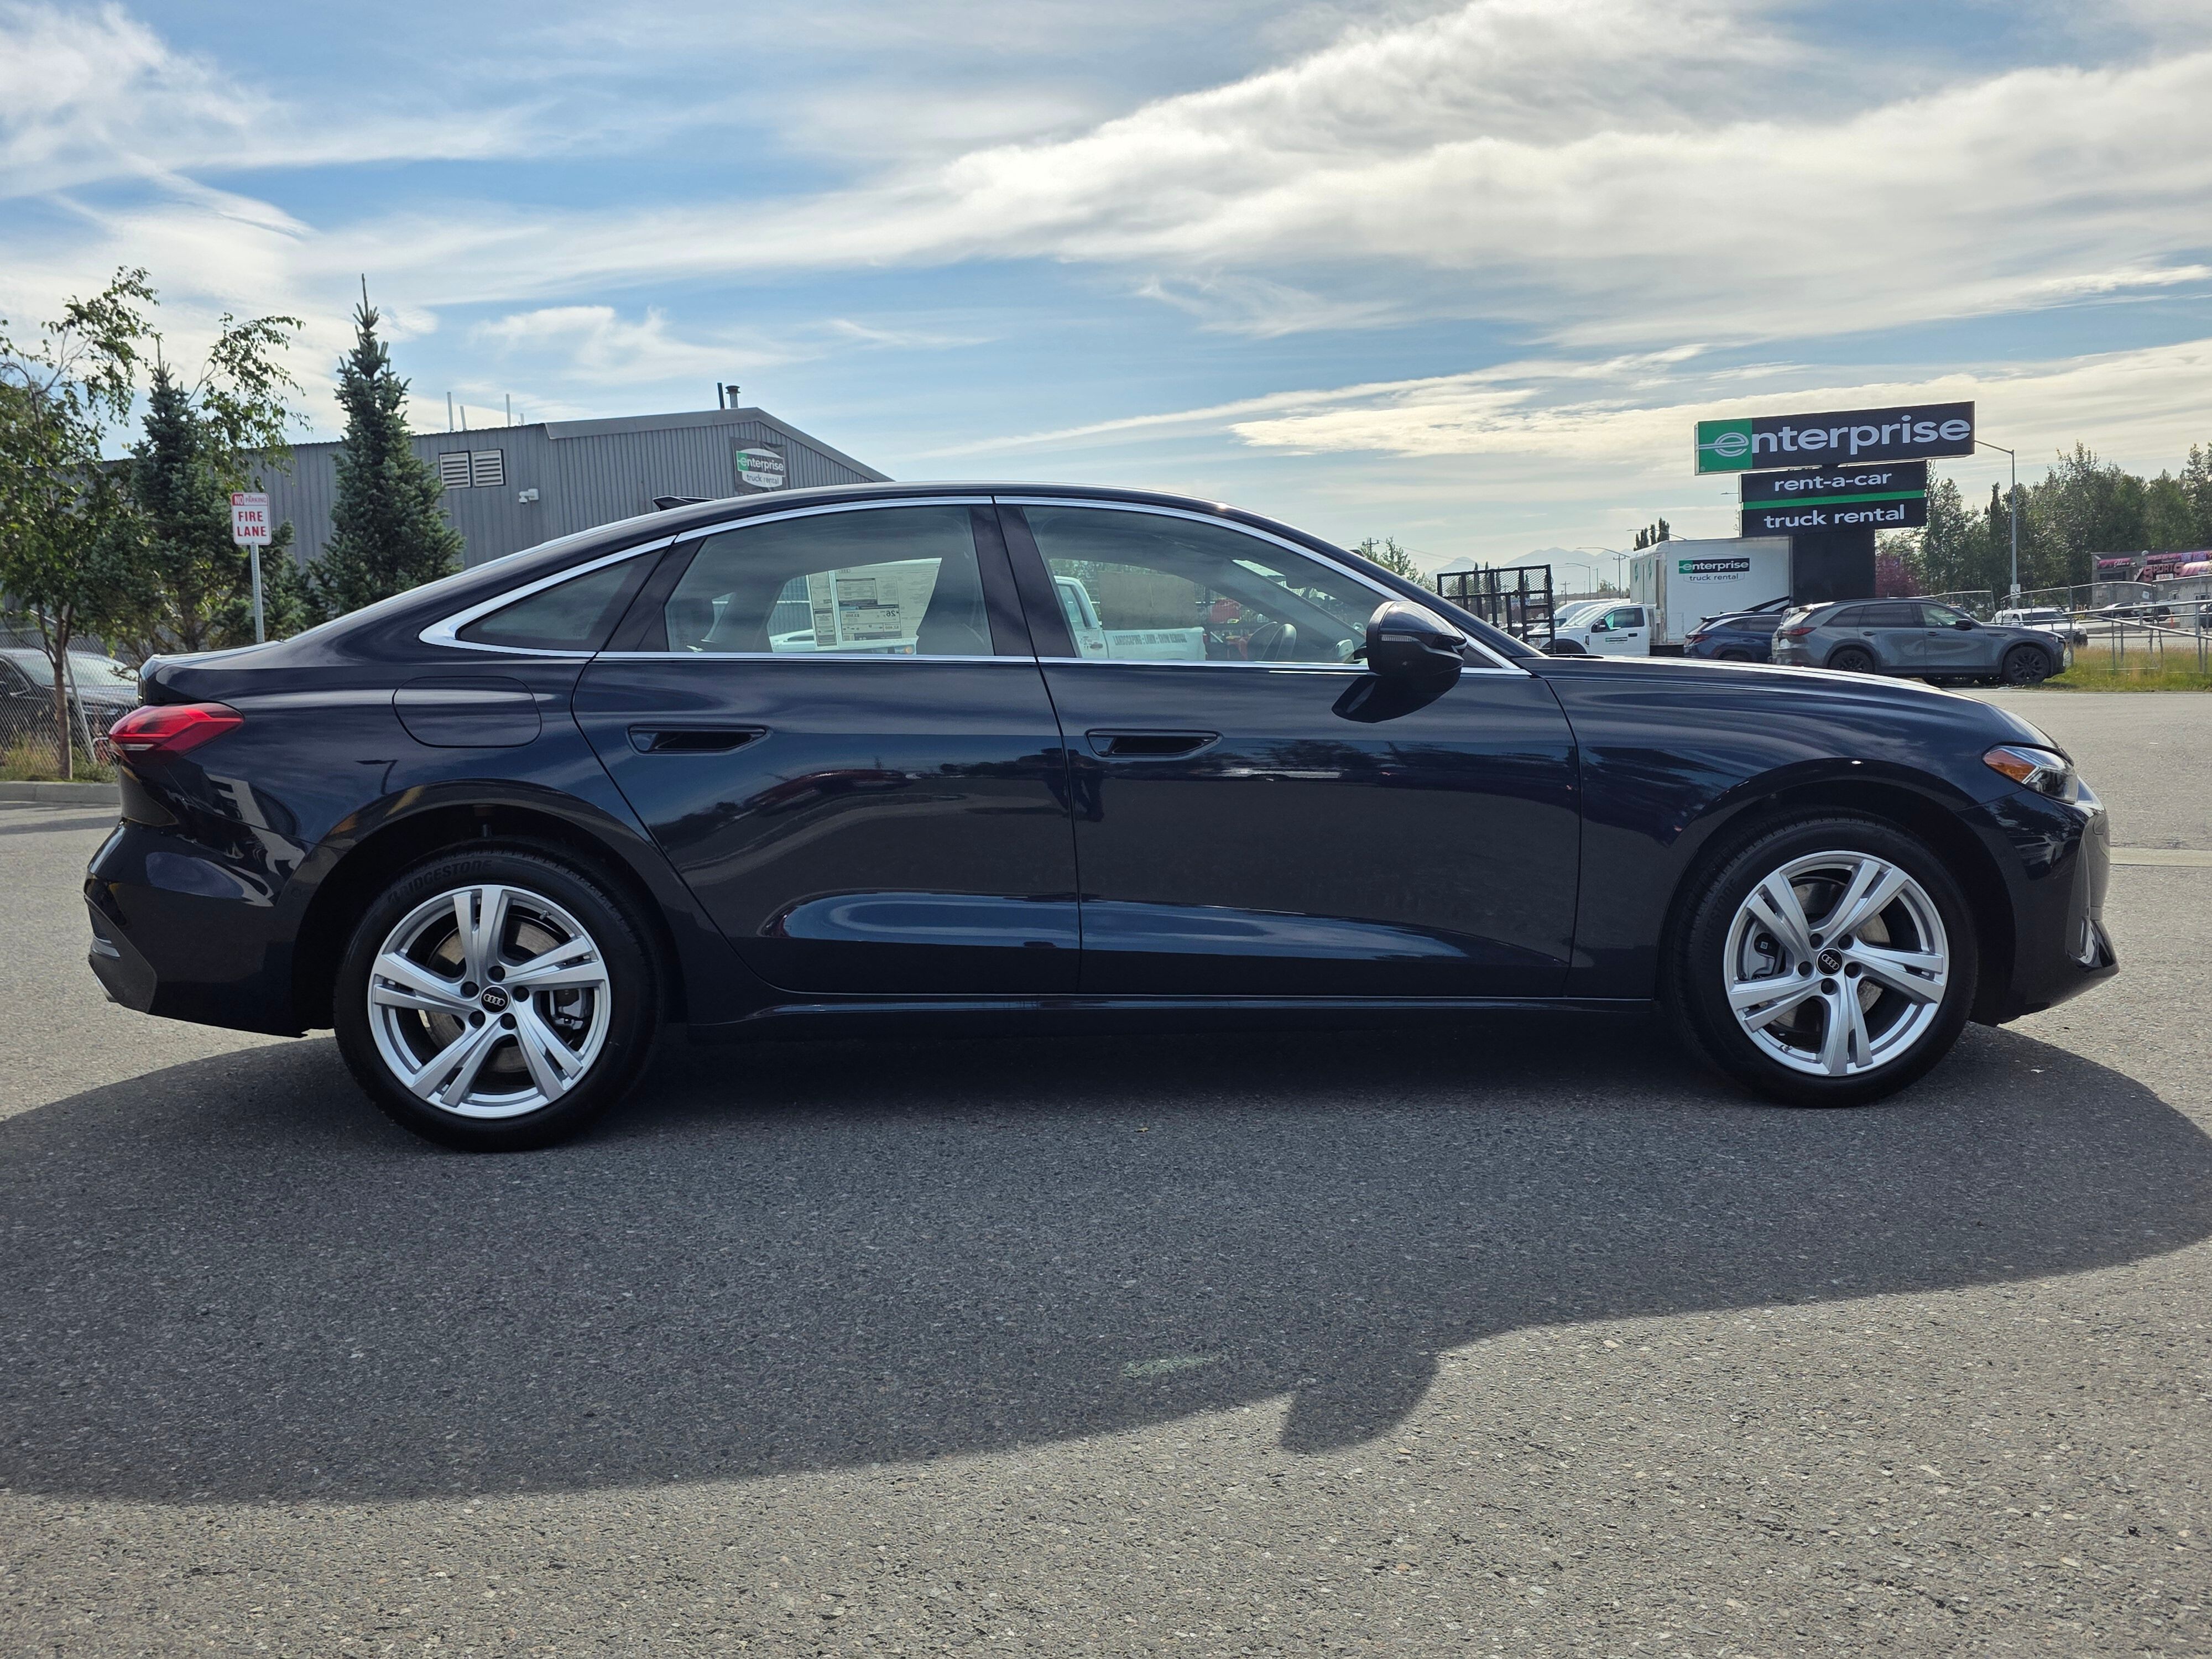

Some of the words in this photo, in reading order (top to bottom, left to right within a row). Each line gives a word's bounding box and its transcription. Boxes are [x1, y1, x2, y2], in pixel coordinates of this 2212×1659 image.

[1699, 415, 1971, 457] enterprise
[738, 457, 784, 471] enterprise
[747, 473, 762, 483] truck
[1774, 472, 1892, 492] rent-a-car
[234, 495, 244, 505] NO
[238, 511, 264, 522] FIRE
[1764, 510, 1827, 529] truck
[1834, 504, 1905, 524] rental
[237, 526, 267, 536] LANE
[1679, 560, 1749, 571] enterprise
